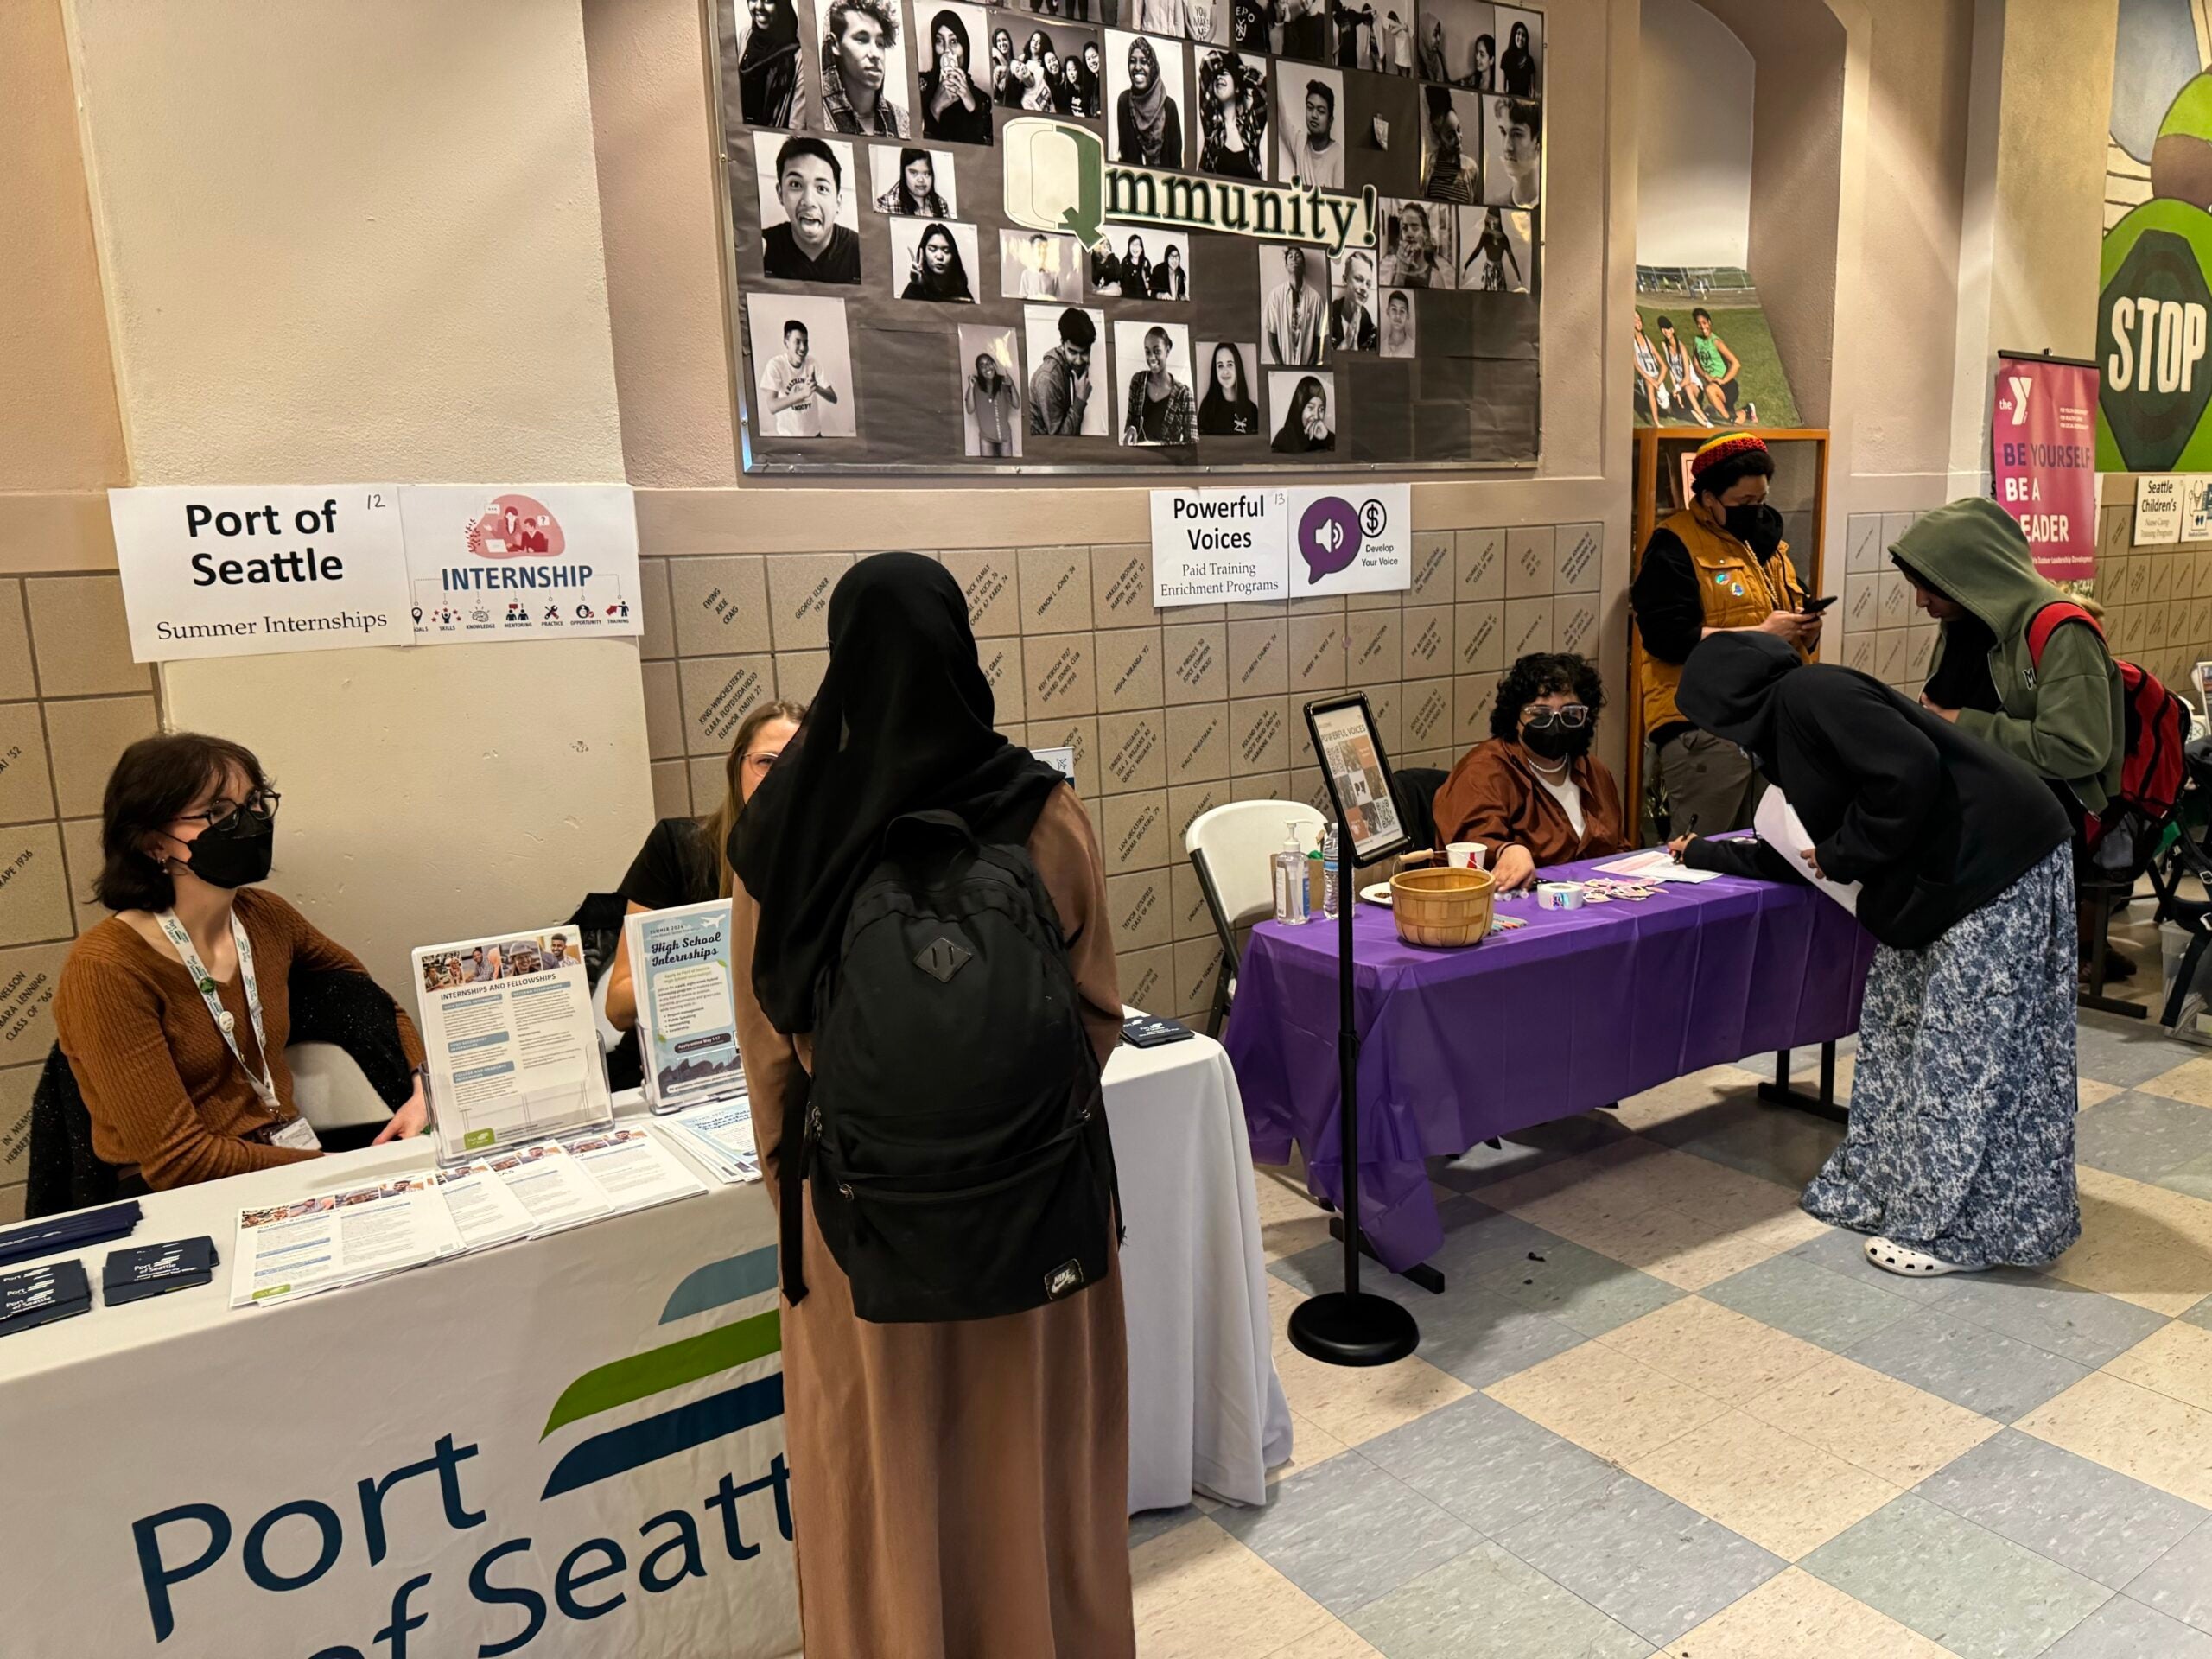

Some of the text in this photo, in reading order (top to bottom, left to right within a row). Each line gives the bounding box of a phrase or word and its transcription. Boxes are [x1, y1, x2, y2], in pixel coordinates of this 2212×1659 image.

[2108, 296, 2207, 394] STOP
[1999, 398, 2012, 410] the
[2003, 442, 2091, 469] BE YOURSELF
[2005, 477, 2029, 502] BE
[2032, 477, 2041, 502] A
[2148, 480, 2174, 494] Seattle
[366, 494, 385, 510] 12
[1173, 495, 1265, 519] Powerful
[1274, 493, 1286, 505] 13
[2142, 499, 2177, 513] Children's
[186, 499, 337, 537] Port of
[2018, 514, 2069, 543] EADER
[1187, 528, 1252, 550] Voices
[1365, 543, 1395, 555] Develop
[191, 548, 343, 586] Seattle
[1182, 562, 1256, 577] Paid Training
[1362, 556, 1399, 567] Your Voice
[442, 565, 593, 591] INTERNSHIP
[965, 563, 990, 597] BECK FAMILY
[979, 579, 993, 596] ALICIA
[1104, 557, 1138, 601] MAKELA BROTHERS
[1161, 580, 1279, 597] Enrichment Programs
[702, 587, 721, 609] EWING
[794, 576, 829, 619] GEORGE ELSNER
[1036, 573, 1069, 615] VERNON JONES
[1109, 571, 1139, 610] MARTIN RAY
[1124, 589, 1137, 606] KEVIN
[715, 597, 728, 615] JULIE
[722, 605, 738, 625] CRAIG
[813, 598, 825, 613] 1936
[966, 607, 983, 626] CHUCK
[156, 612, 387, 639] Summer Internships
[988, 651, 1003, 671] GRANT
[1125, 654, 1142, 677] MIRANDA
[1175, 665, 1184, 677] THE
[1182, 645, 1210, 683] JOYCE COMPTON
[1241, 641, 1271, 683] ELIZABETH CHURCH
[1301, 659, 1314, 677] SHERRY
[1041, 651, 1080, 702] SEWARD TENNIS CLUB
[1191, 672, 1200, 685] BOB
[717, 684, 762, 739] ELEANOR KNUTH 22
[703, 716, 721, 736] CLARA
[1255, 727, 1266, 743] DAVID
[1321, 728, 1349, 743] POWERFUL
[1348, 723, 1366, 735] VOICES
[1241, 728, 1255, 748] ROLAND
[1108, 728, 1140, 771] LINDSEY WILLIAMS
[1116, 735, 1145, 777] LISA WILLIAMS
[1250, 738, 1268, 763] MARIANNE
[1121, 741, 1152, 783] QUINCY WILLIAMS
[1126, 814, 1145, 840] DECASTRO
[1135, 815, 1154, 840] DECASTRO
[14, 849, 33, 868] 1936
[1122, 886, 1153, 929] TREVOR LITTLEFIELD
[1130, 914, 1142, 931] CLASS
[1141, 906, 1147, 916] OF
[167, 918, 178, 931] Port
[652, 931, 722, 955] High School
[652, 948, 719, 967] Internships
[16, 972, 47, 1005] LENNING
[441, 973, 556, 1001] INTERNSHIPS AND FELLOWSHIPS
[1143, 983, 1150, 993] OF
[1189, 979, 1204, 1000] CARMEN
[26, 1004, 38, 1018] OF
[1, 1134, 13, 1146] IN
[149, 1262, 176, 1273] Seattle
[1053, 1269, 1071, 1284] NIKE
[22, 1296, 52, 1308] Seattle
[131, 1433, 488, 1643] Port
[308, 1452, 792, 1659] f Seatt
